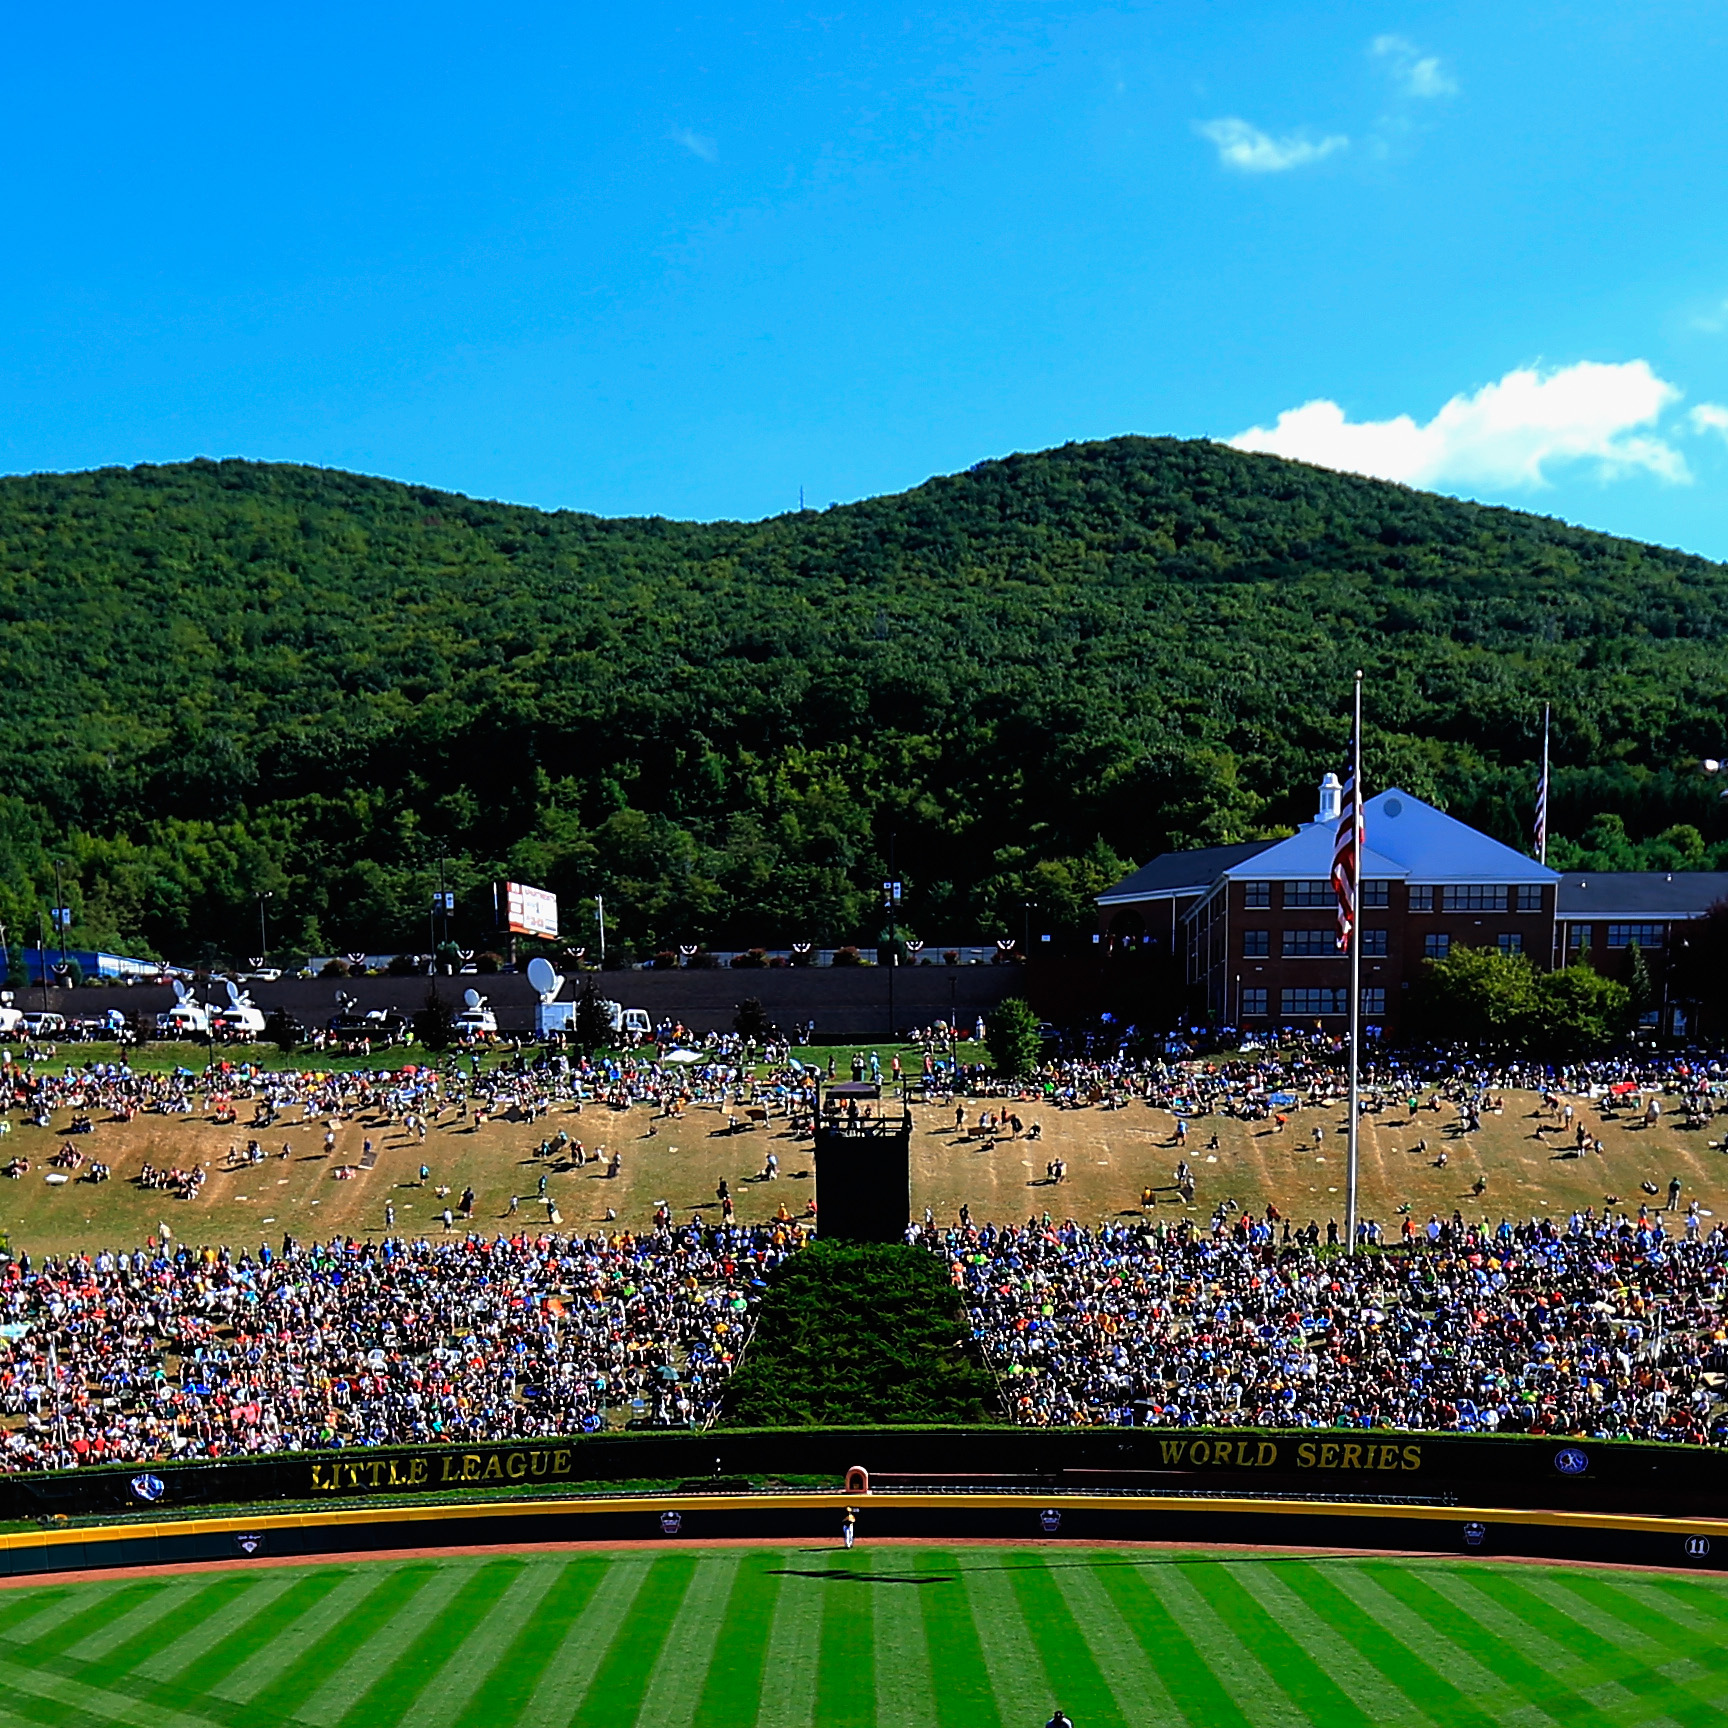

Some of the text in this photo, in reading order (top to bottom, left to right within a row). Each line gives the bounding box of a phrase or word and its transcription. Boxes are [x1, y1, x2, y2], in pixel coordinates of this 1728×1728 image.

[309, 1449, 572, 1491] LITTLE LEAGUE
[1159, 1440, 1422, 1471] WORLD SERIES
[1689, 1538, 1706, 1554] 11
